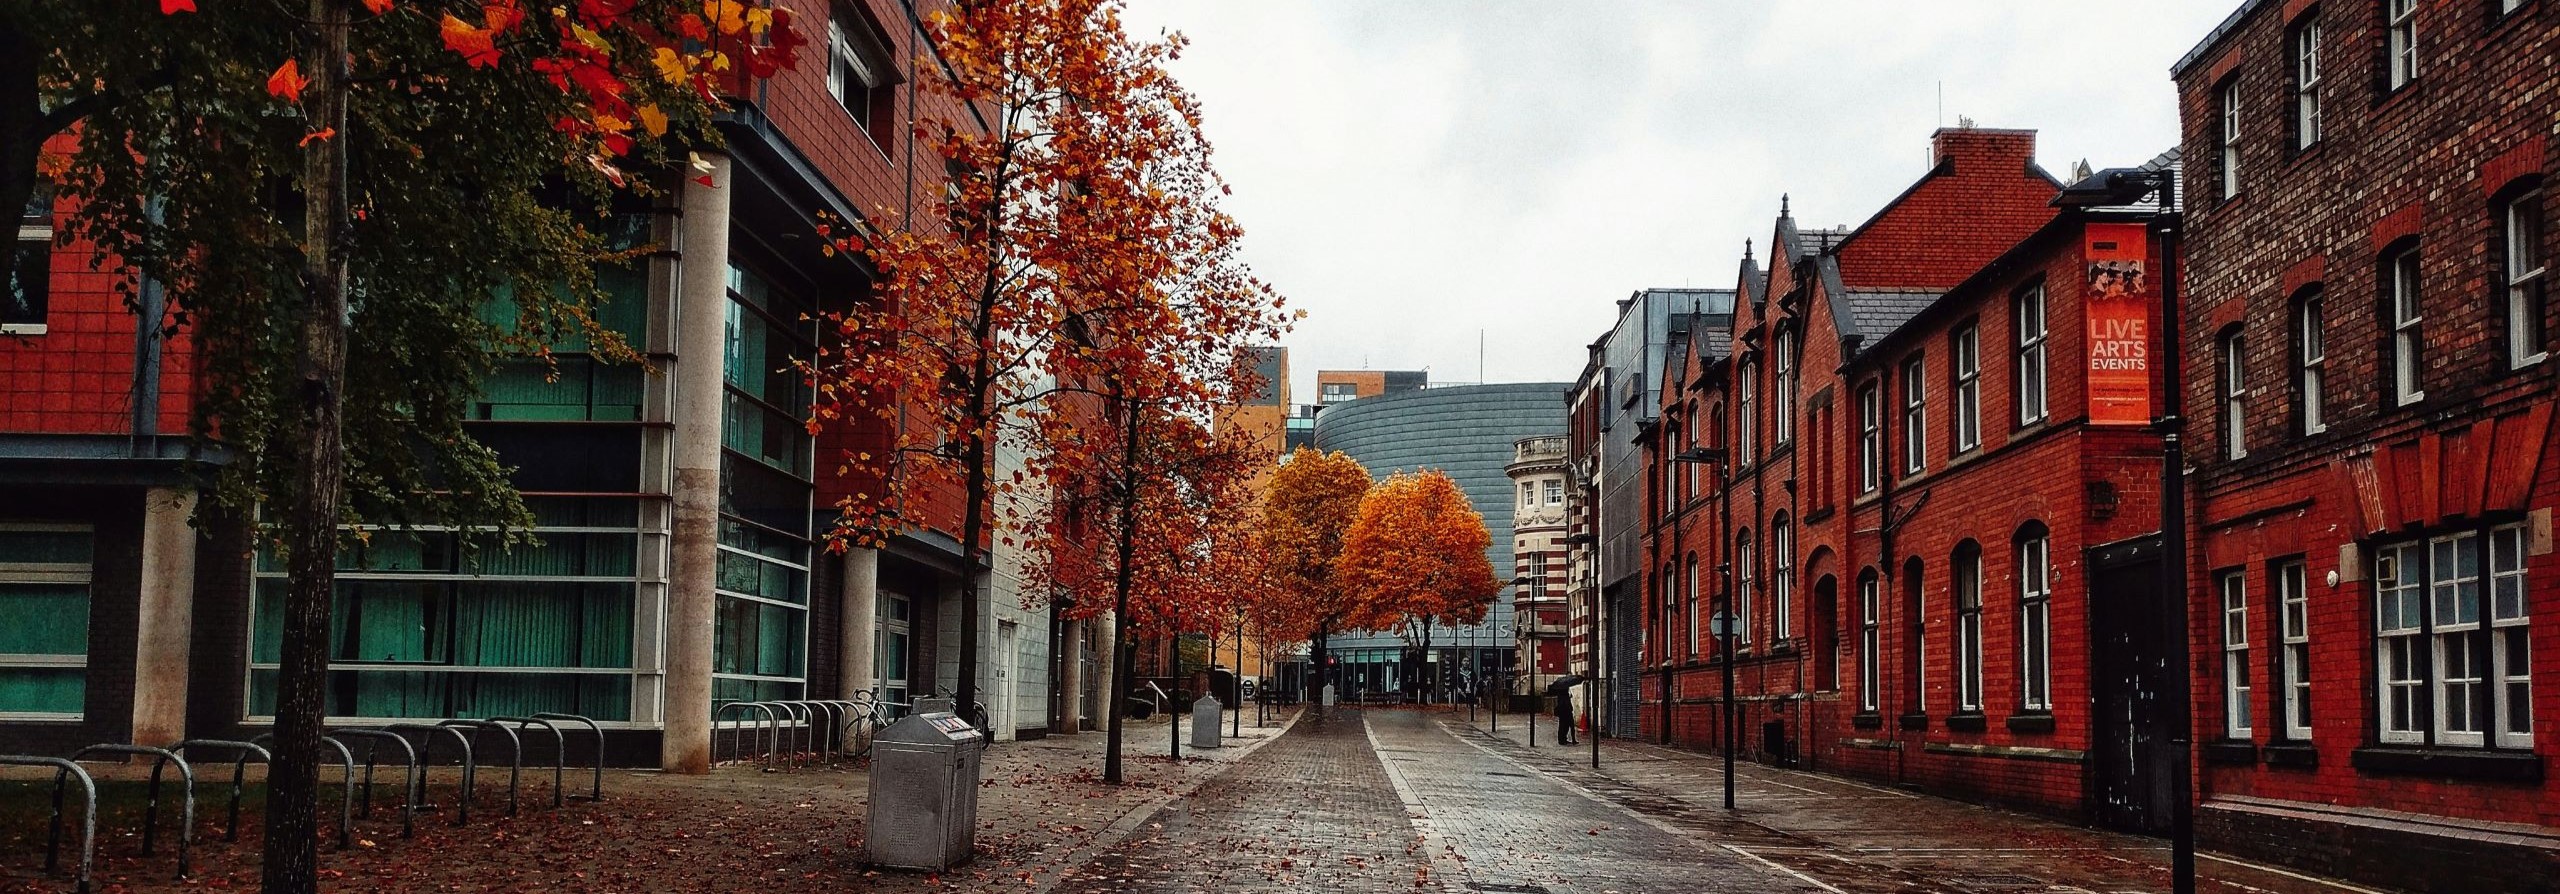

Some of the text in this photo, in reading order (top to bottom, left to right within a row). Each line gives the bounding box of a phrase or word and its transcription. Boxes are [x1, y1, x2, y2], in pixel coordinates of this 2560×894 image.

[2090, 318, 2146, 339] LIVE
[2092, 340, 2146, 358] ARTS
[2091, 358, 2146, 371] EVENTS
